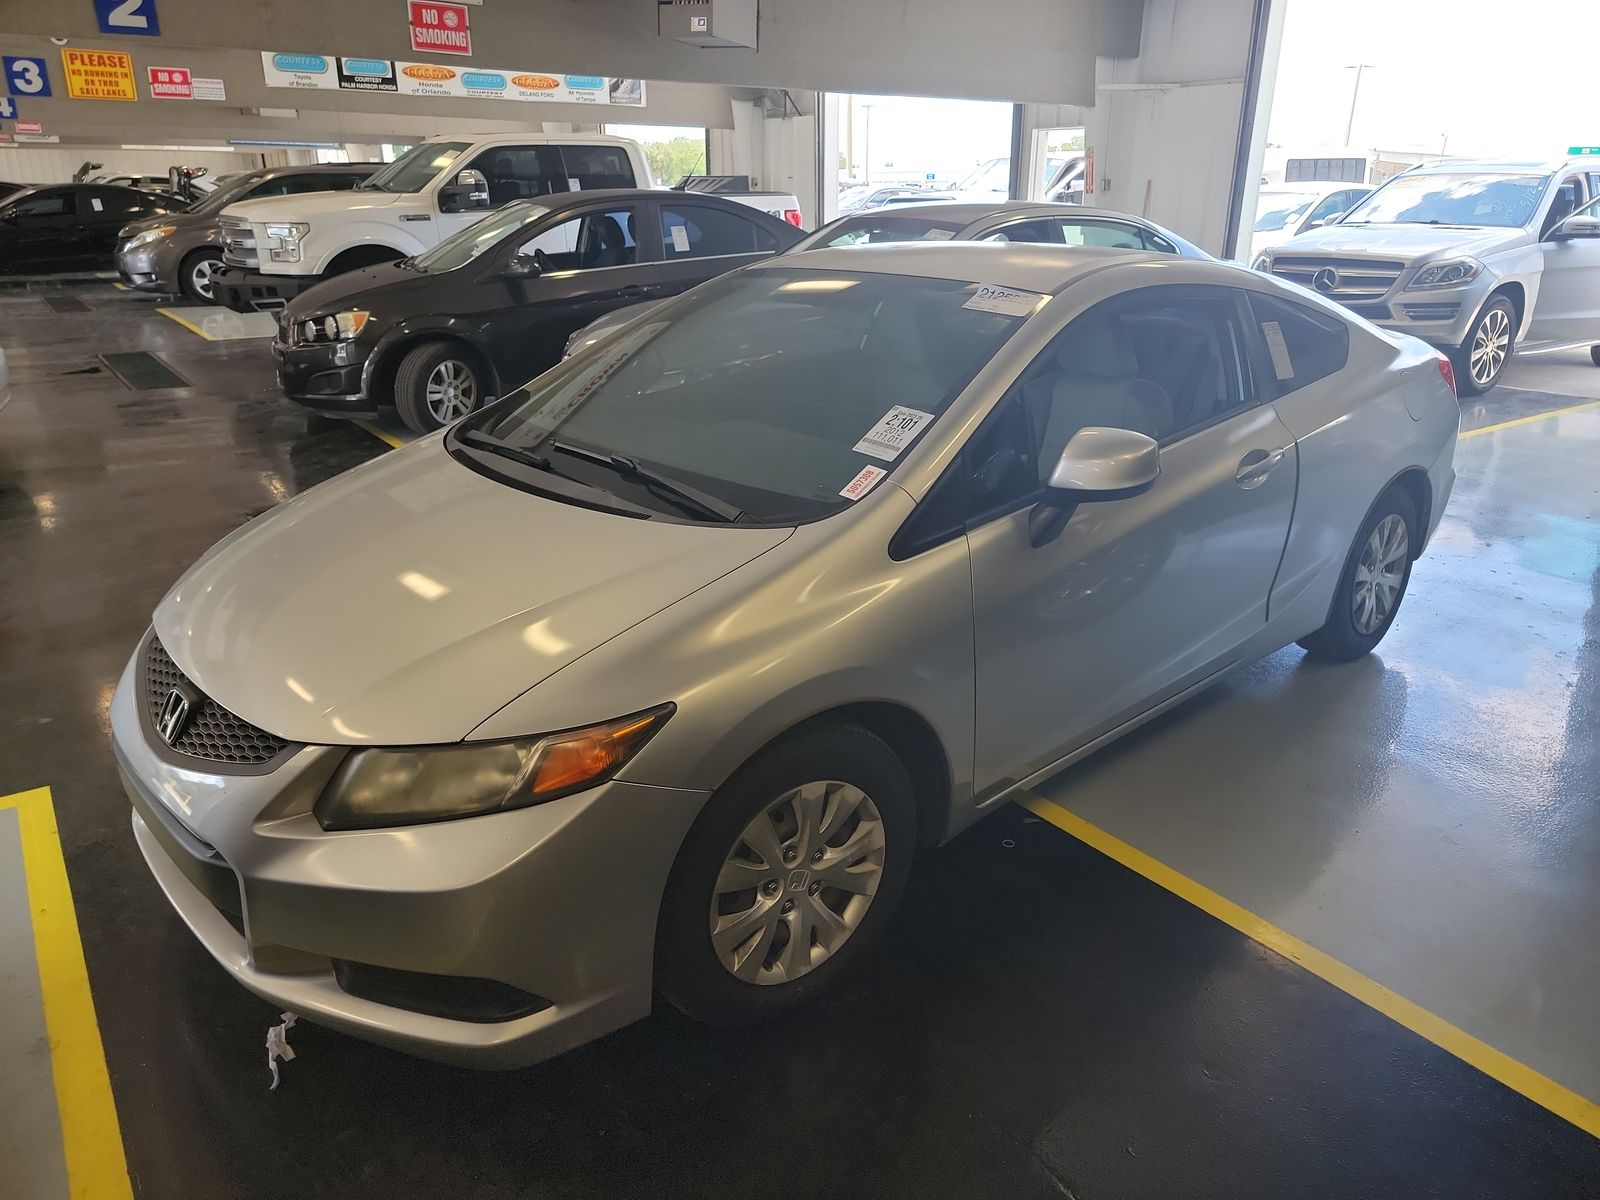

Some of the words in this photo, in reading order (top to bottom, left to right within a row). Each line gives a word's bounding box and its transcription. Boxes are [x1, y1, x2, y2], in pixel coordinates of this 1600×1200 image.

[108, 0, 148, 28] 2
[422, 9, 438, 25] NO
[416, 28, 467, 47] SMOKING
[69, 53, 126, 68] PLEASE
[276, 55, 322, 66] COURTESY
[12, 60, 43, 93] 3
[84, 70, 119, 78] RUNNING
[157, 72, 169, 82] NO
[154, 83, 190, 94] SMOKING
[884, 427, 905, 437] 2012
